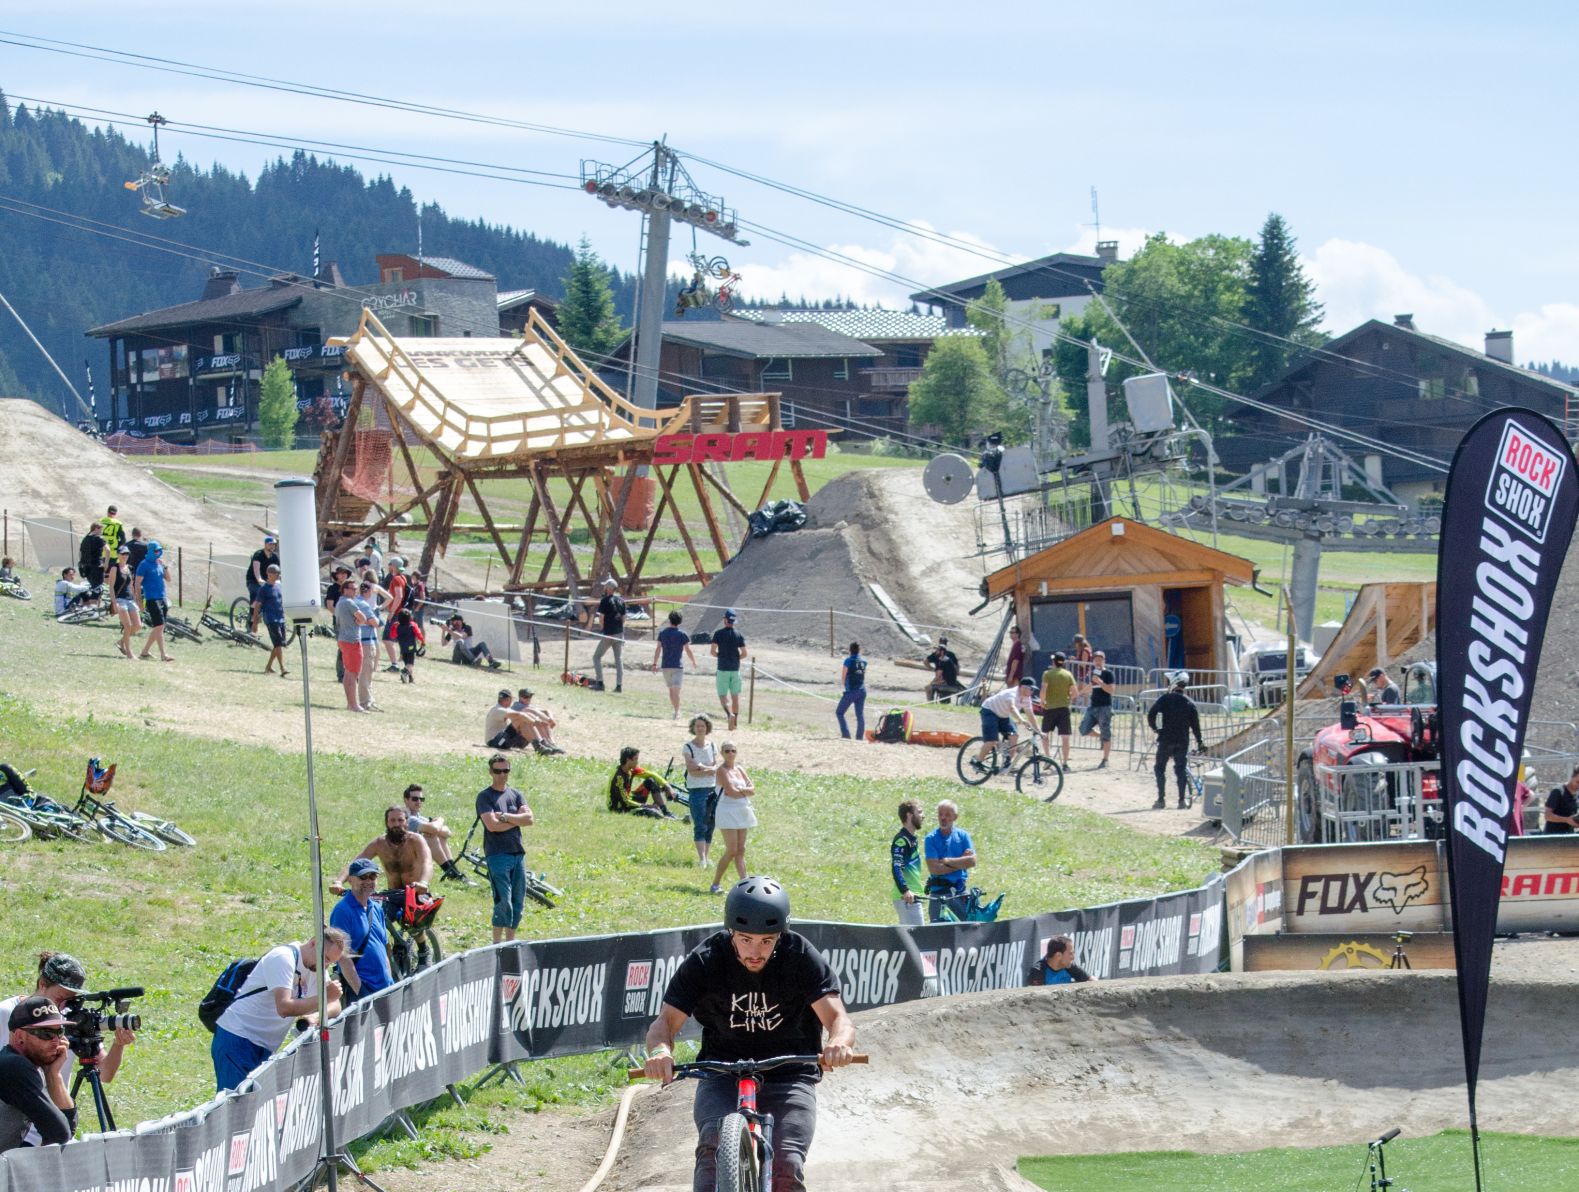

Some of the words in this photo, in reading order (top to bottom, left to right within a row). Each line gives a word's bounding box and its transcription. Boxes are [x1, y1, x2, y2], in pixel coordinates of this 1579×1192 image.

[211, 356, 228, 368] FOX
[284, 349, 300, 360] FOX
[321, 346, 340, 357] FOX
[144, 416, 161, 428] FOX
[651, 430, 828, 464] SRAM
[1505, 434, 1557, 491] ROCK
[1495, 473, 1546, 529] SHOX
[1454, 517, 1541, 864] ROCKSHOX
[1296, 872, 1376, 916] FOX
[627, 965, 650, 987] ROCK
[939, 940, 1026, 996] ROCKSHOX
[624, 991, 647, 1014] SHOX
[731, 992, 779, 1013] KILL
[730, 1013, 784, 1033] LINE
